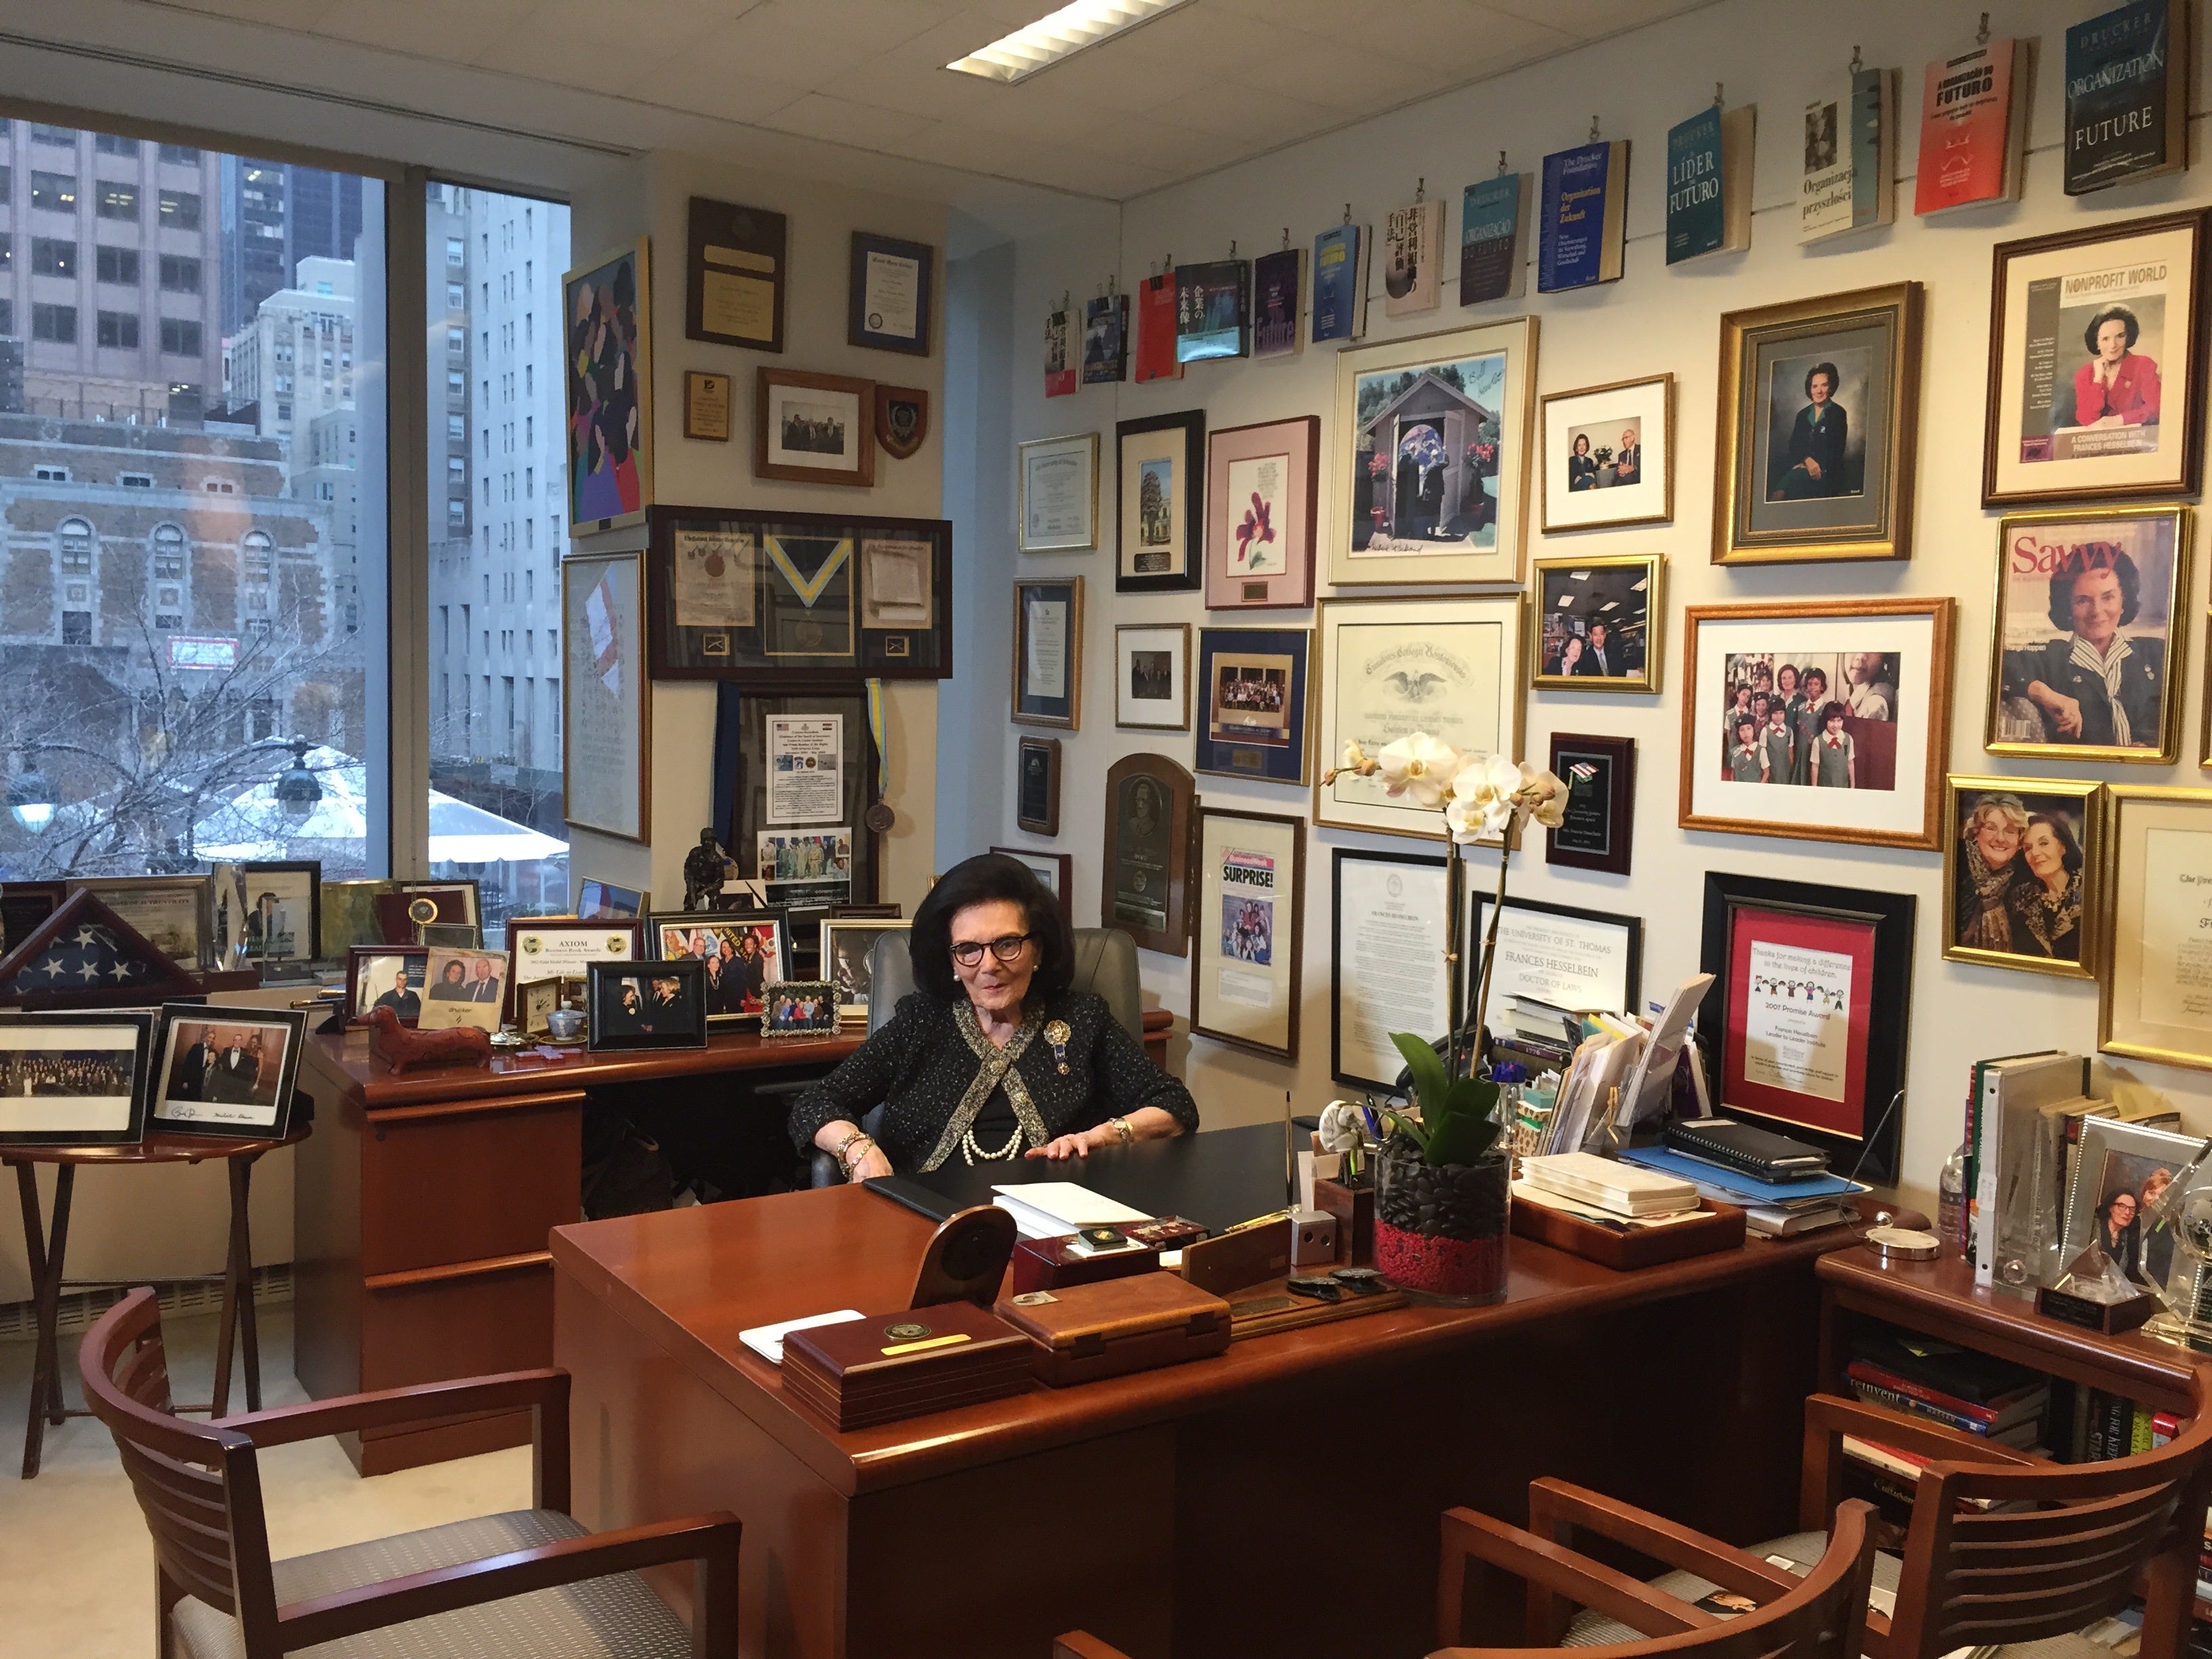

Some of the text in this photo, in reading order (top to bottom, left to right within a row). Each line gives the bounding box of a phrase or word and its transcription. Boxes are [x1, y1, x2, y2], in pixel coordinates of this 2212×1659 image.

[2068, 49, 2165, 99] ORGANIZATION
[1936, 77, 1993, 107] FUTURO
[2075, 106, 2153, 150] FUTURE
[1673, 150, 1715, 185] LÍDER
[1803, 165, 1858, 195] Organizacja
[1670, 177, 1719, 214] FUTURO
[2066, 264, 2167, 293] NONPROFIT WORLD
[1193, 285, 1204, 319] 企業の
[2071, 430, 2146, 444] A CONVERSATION WITH
[2073, 443, 2102, 452] FRANCES
[2013, 535, 2123, 579] Savvy
[1223, 865, 1273, 888] SURPRISE!
[1511, 929, 1552, 944] UNIVERSITY
[1553, 936, 1563, 946] OF
[1579, 940, 1611, 954] THOMAS
[1505, 951, 1599, 978] FRANCES HESSELBEIN
[1753, 947, 1775, 958] Thanks
[1788, 955, 1811, 966] making
[1818, 959, 1851, 971] difference
[1784, 963, 1799, 972] lives
[1800, 966, 1807, 975] of
[1808, 968, 1837, 979] children.
[1519, 972, 1583, 994] DOCTOR OF LAWS
[1765, 1002, 1831, 1020] 2007 Promise Award
[1766, 1031, 1782, 1039] Leader
[1789, 1036, 1805, 1044] Leader
[1525, 1047, 1540, 1056] 1776
[1851, 1378, 1900, 1402] reinvent
